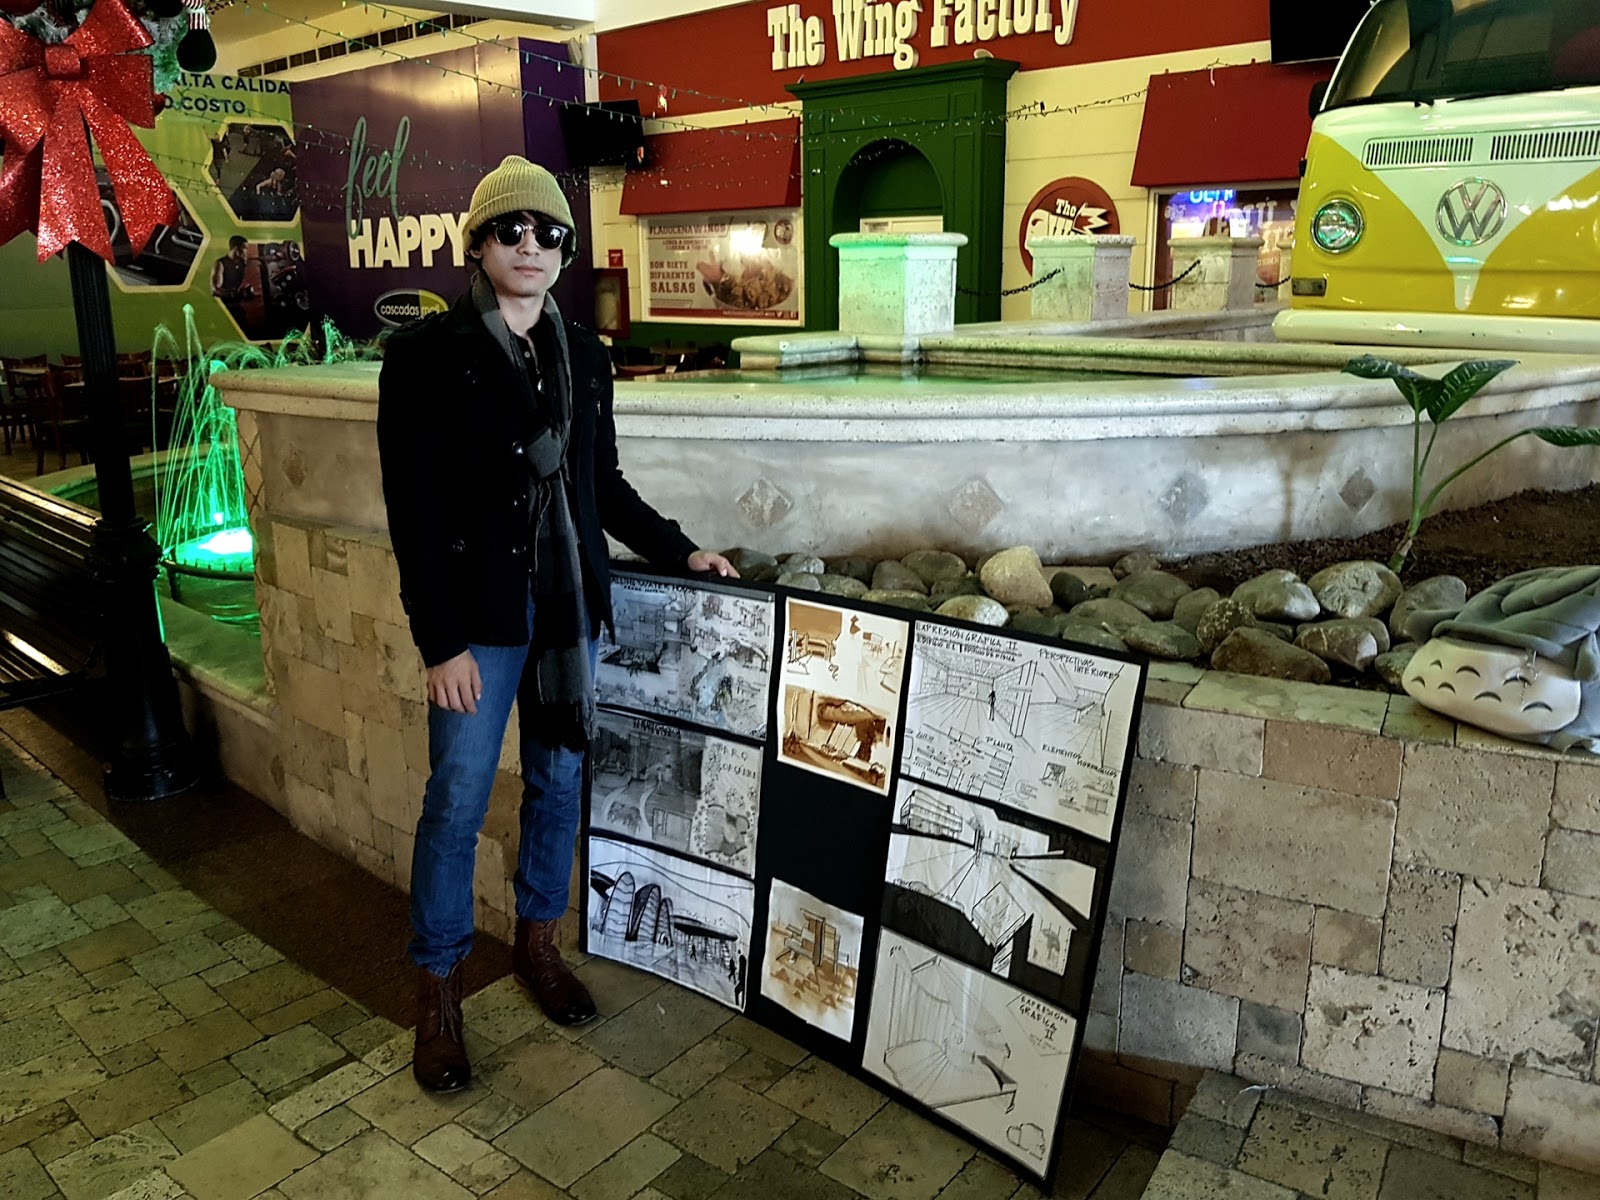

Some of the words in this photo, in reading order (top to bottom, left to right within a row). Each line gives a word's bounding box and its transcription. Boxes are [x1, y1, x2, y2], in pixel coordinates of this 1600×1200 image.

[767, 3, 825, 71] The
[832, 0, 923, 71] Wing
[930, 0, 1078, 48] Factory
[180, 96, 246, 114] COSTO
[341, 116, 411, 240] feel
[1055, 198, 1077, 218] The
[349, 212, 471, 270] HAPPY
[650, 271, 696, 280] DIFERENTES
[650, 281, 696, 294] SALSAS
[380, 303, 419, 316] cascadas
[1042, 743, 1082, 760] ELEMENTOS
